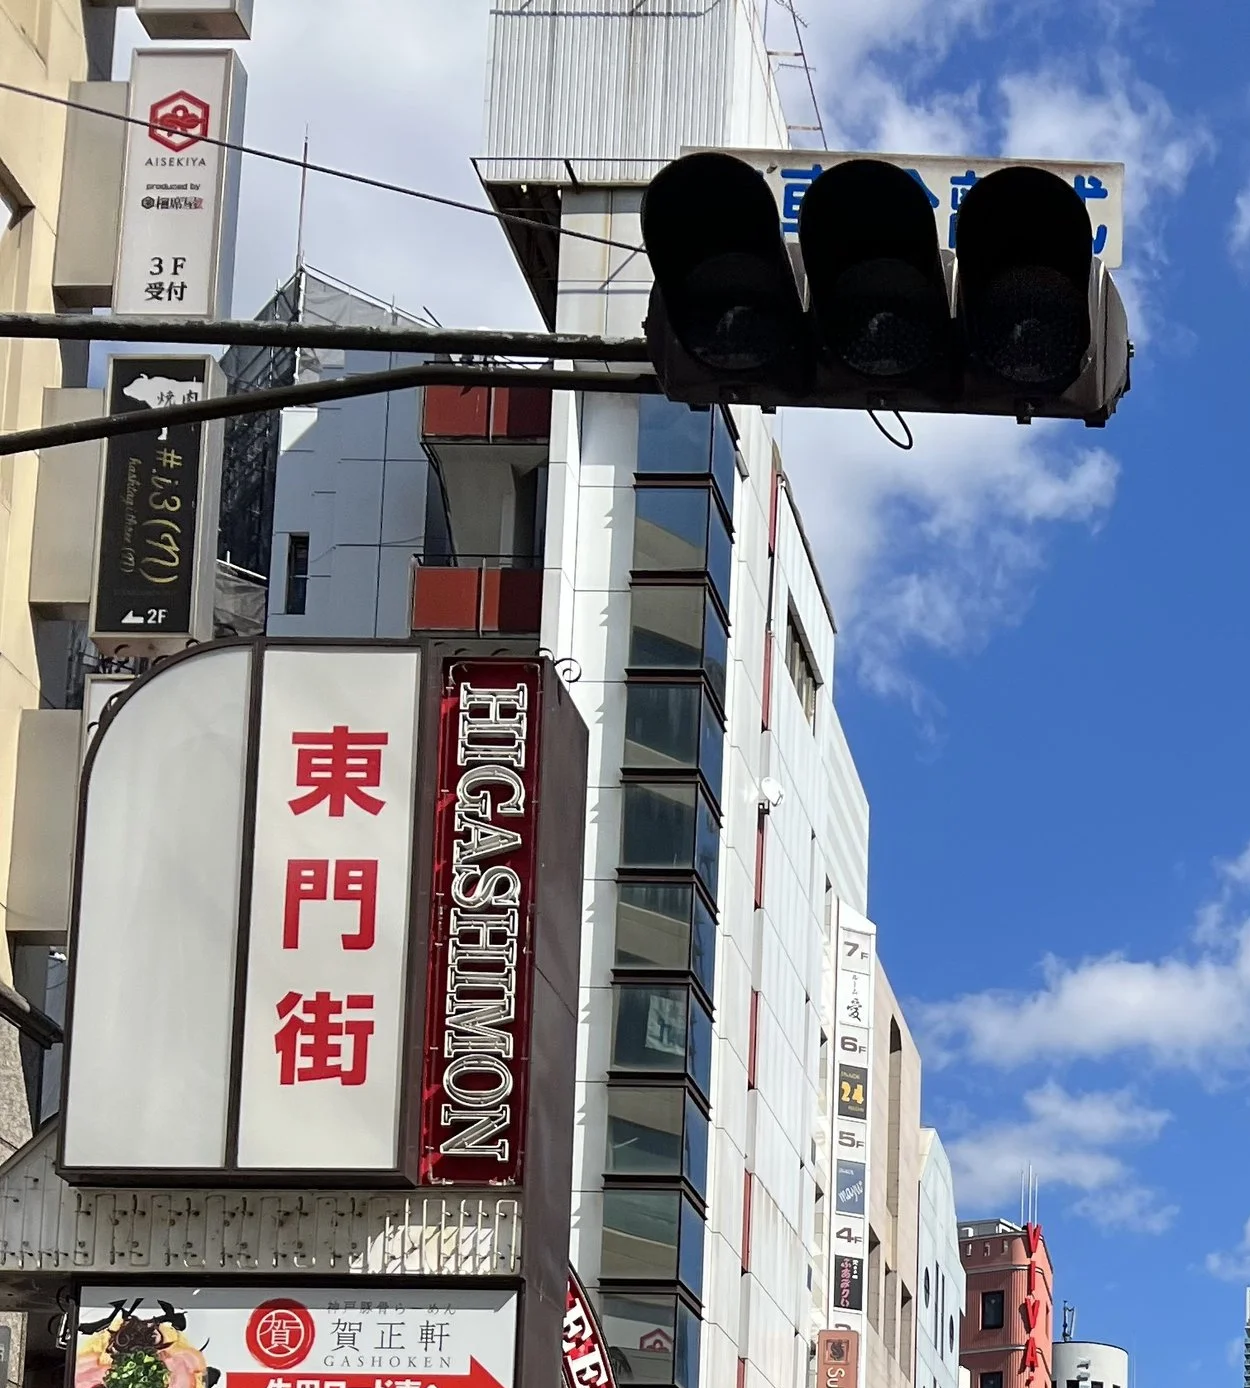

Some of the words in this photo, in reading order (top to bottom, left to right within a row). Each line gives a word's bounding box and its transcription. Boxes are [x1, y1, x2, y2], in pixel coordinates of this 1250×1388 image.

[145, 157, 206, 167] AISEKIYA
[144, 281, 188, 301] 受付
[147, 609, 168, 624] 2F
[274, 725, 390, 1087] 東門街
[441, 681, 529, 1162] HIGASHIMON
[843, 941, 869, 960] 7F
[840, 1036, 867, 1054] 6F
[841, 1081, 865, 1105] 24
[838, 1131, 865, 1149] 5F
[835, 1227, 863, 1243] 4F
[1024, 1222, 1042, 1374] VIVA
[326, 1300, 457, 1316] 神戸豚骨らーめん
[330, 1318, 451, 1353] 賀正軒
[323, 1355, 452, 1369] GASHOKEN
